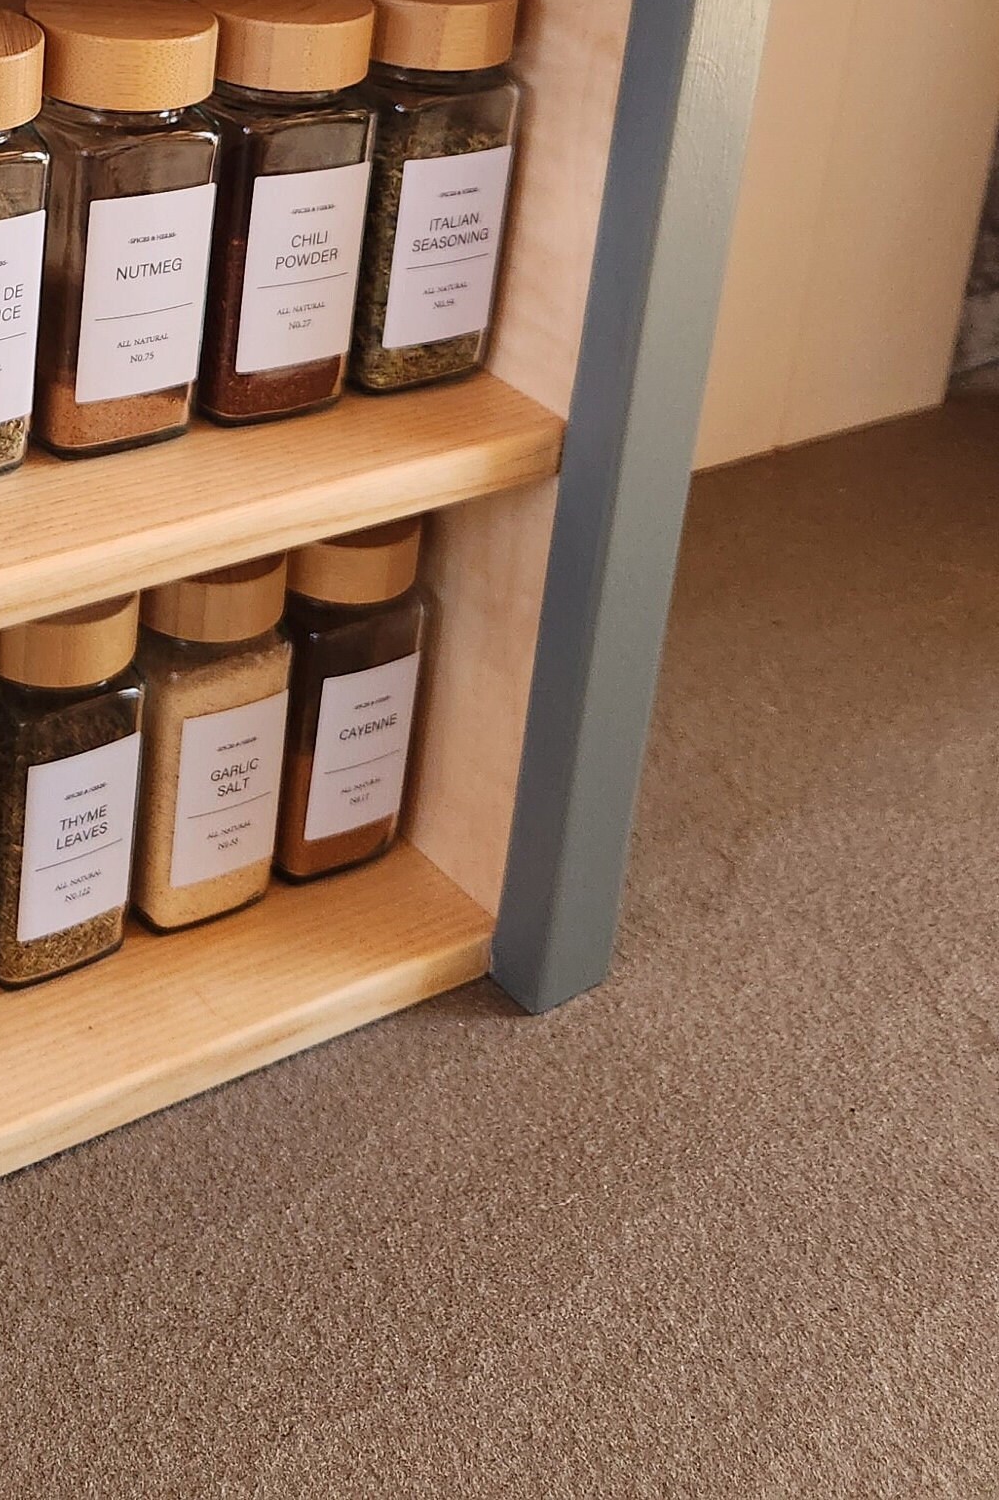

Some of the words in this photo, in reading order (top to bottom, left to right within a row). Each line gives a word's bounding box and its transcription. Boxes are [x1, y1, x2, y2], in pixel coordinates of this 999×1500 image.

[429, 213, 479, 232] ITALIAN
[291, 231, 328, 248] CHILI
[412, 228, 489, 253] SEASONING
[116, 257, 183, 281] NUTMEG
[275, 248, 338, 270] POWDER
[4, 283, 24, 300] DE
[116, 340, 131, 348] ALL
[133, 333, 169, 346] NATURAL
[339, 713, 398, 741] CAYENNE
[210, 758, 259, 782] GARLIC
[217, 777, 250, 797] SALT
[59, 804, 108, 831] THYME
[56, 821, 109, 851] LEAVES
